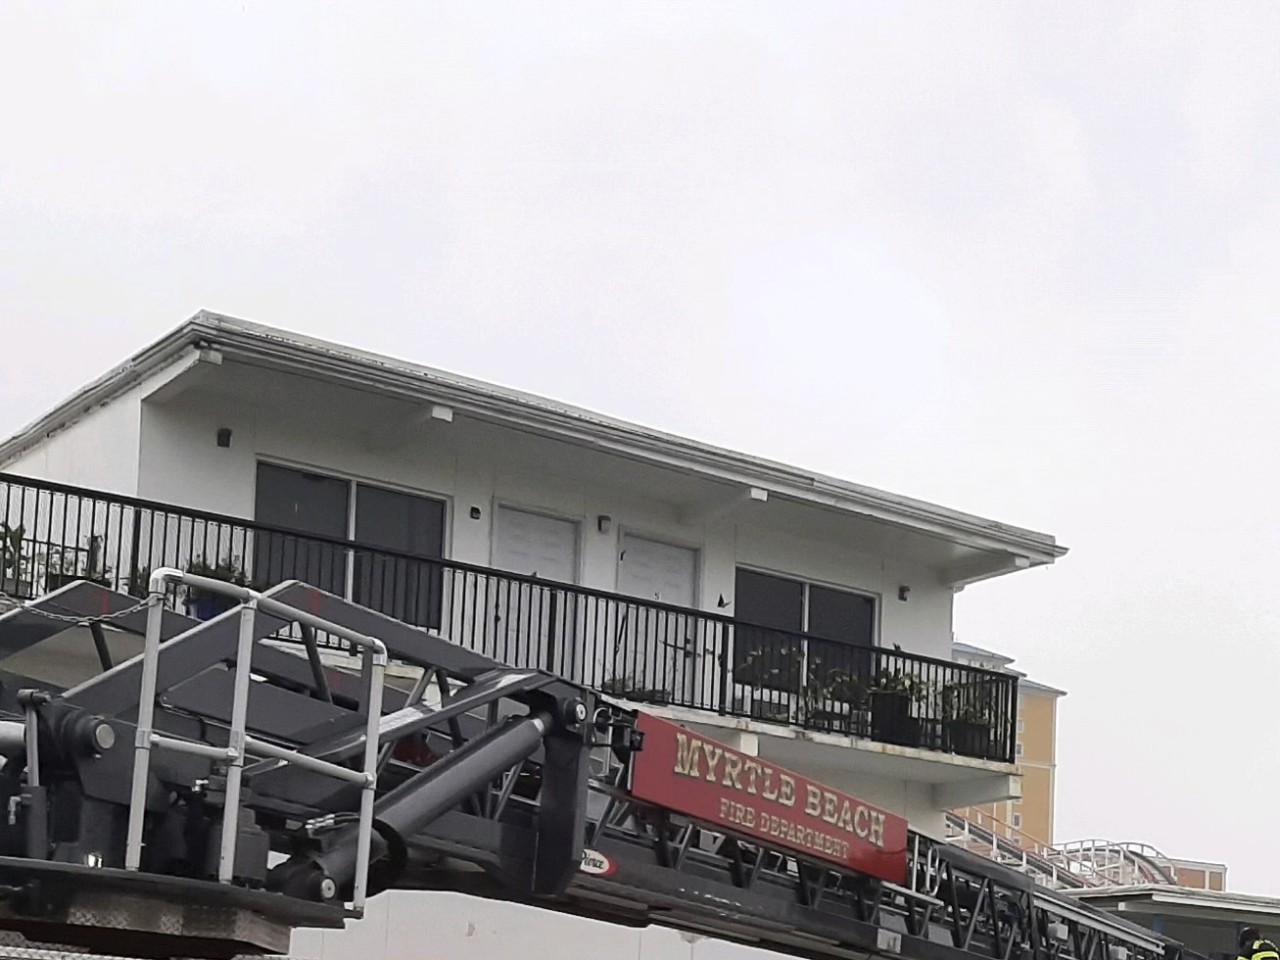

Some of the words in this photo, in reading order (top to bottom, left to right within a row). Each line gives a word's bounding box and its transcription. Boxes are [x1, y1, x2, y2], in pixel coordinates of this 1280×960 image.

[674, 732, 796, 807] MYRTLE
[805, 784, 886, 847] BEACH
[719, 797, 756, 828] FIRE
[759, 812, 850, 860] DEPARTMENT
